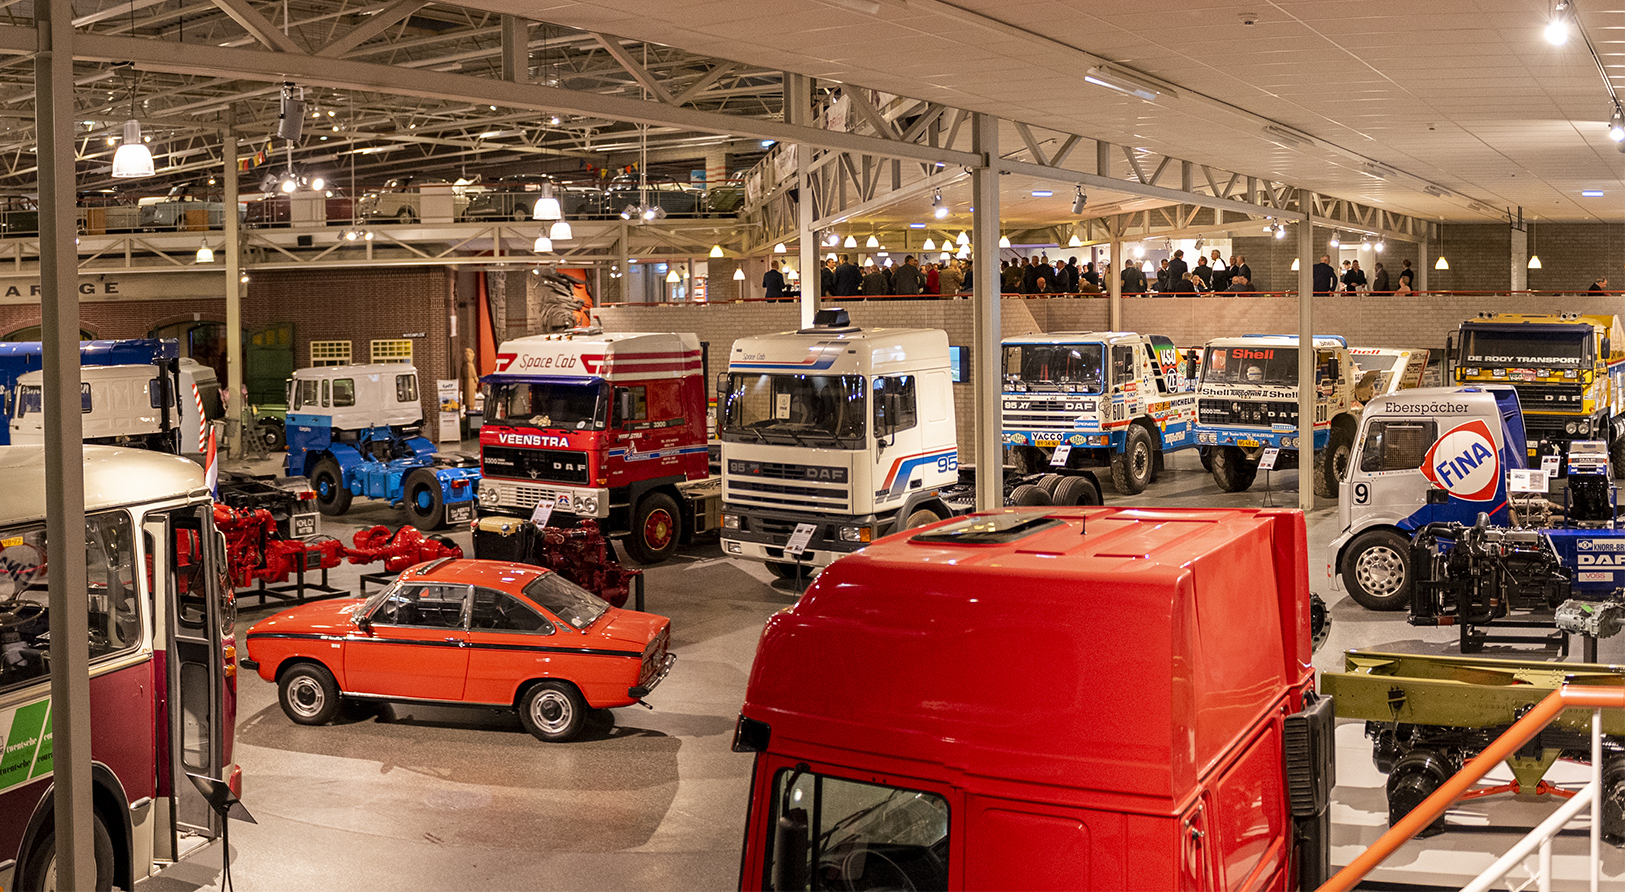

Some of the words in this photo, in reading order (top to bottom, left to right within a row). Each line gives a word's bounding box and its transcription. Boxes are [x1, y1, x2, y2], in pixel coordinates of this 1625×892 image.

[742, 353, 755, 361] Space
[1232, 348, 1275, 360] Shell
[519, 354, 552, 371] Space
[555, 354, 577, 368] Cab
[1515, 356, 1581, 364] TRANSPORT
[1202, 388, 1229, 396] Shell
[1269, 390, 1298, 398] Shell
[1064, 402, 1094, 410] DAF
[1170, 397, 1195, 407] MICHELIN
[1112, 403, 1125, 420] 600
[1385, 402, 1469, 416] Eberspächer
[499, 433, 569, 447] VEENSTRA
[1032, 432, 1063, 441] YACCO
[553, 462, 586, 471] DAF
[730, 461, 746, 472] 95
[937, 456, 958, 473] 95
[1436, 442, 1493, 488] FINA
[806, 468, 844, 480] DAF
[1355, 483, 1368, 504] 9
[1577, 554, 1625, 565] DAF
